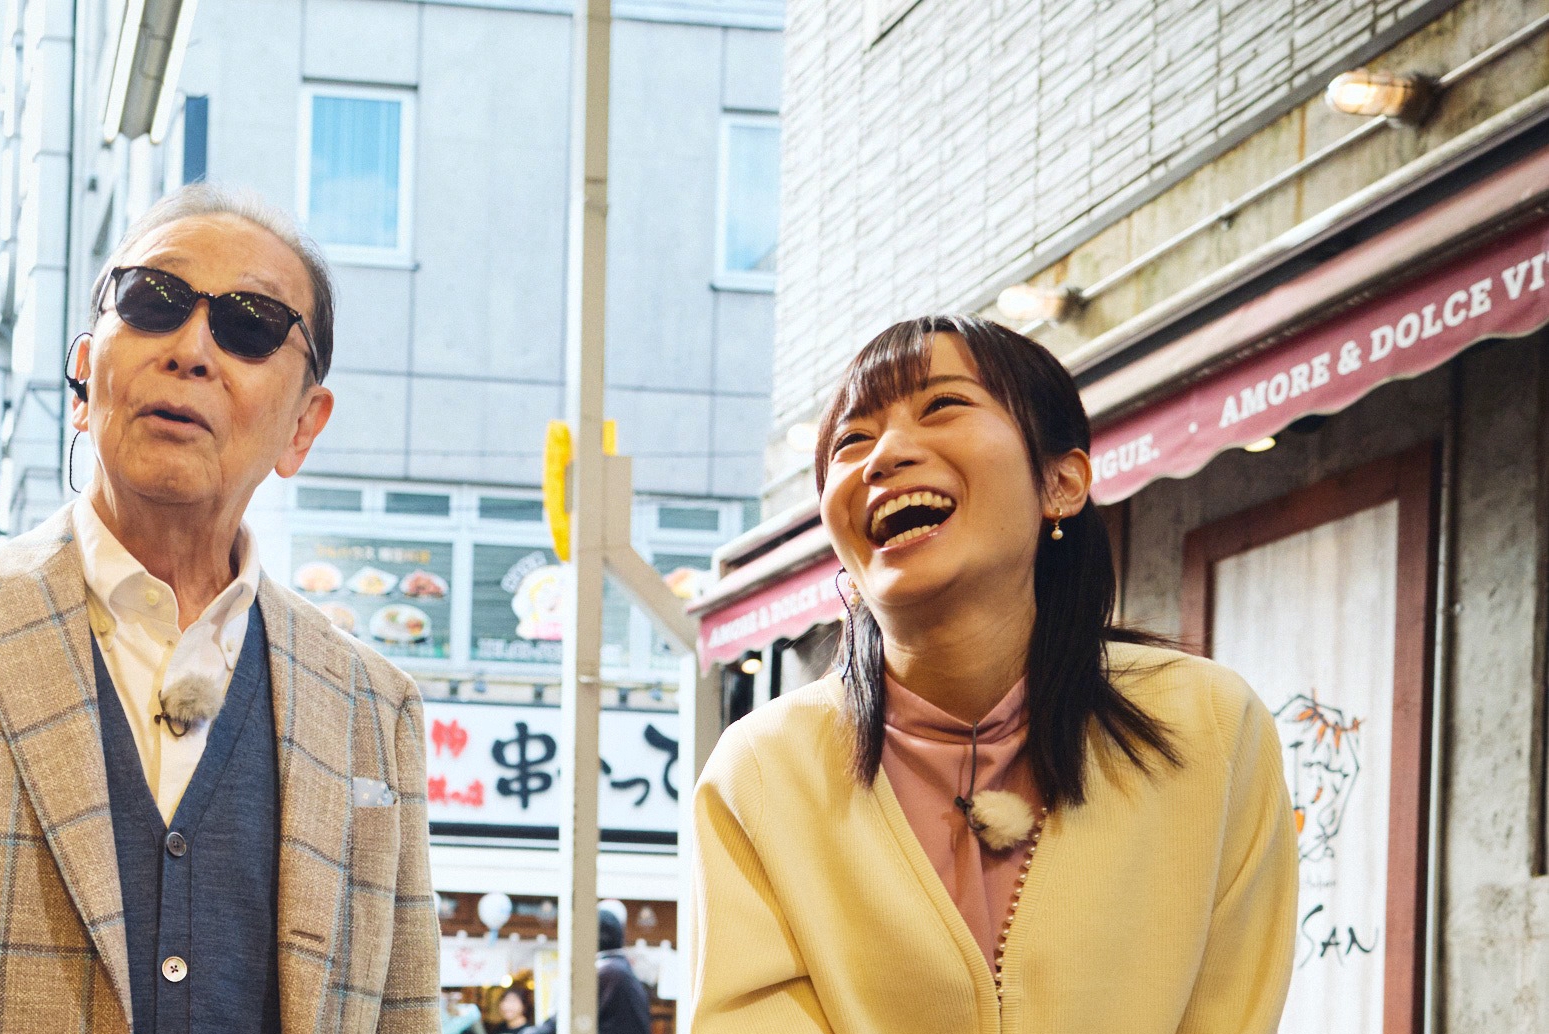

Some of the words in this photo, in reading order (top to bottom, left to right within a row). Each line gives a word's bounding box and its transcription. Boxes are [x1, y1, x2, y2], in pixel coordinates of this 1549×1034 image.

[1219, 352, 1331, 429] AMORE
[1337, 340, 1363, 377] &
[1369, 278, 1493, 363] DOLCE
[1501, 250, 1549, 301] VI
[1092, 432, 1161, 485] IGUE.
